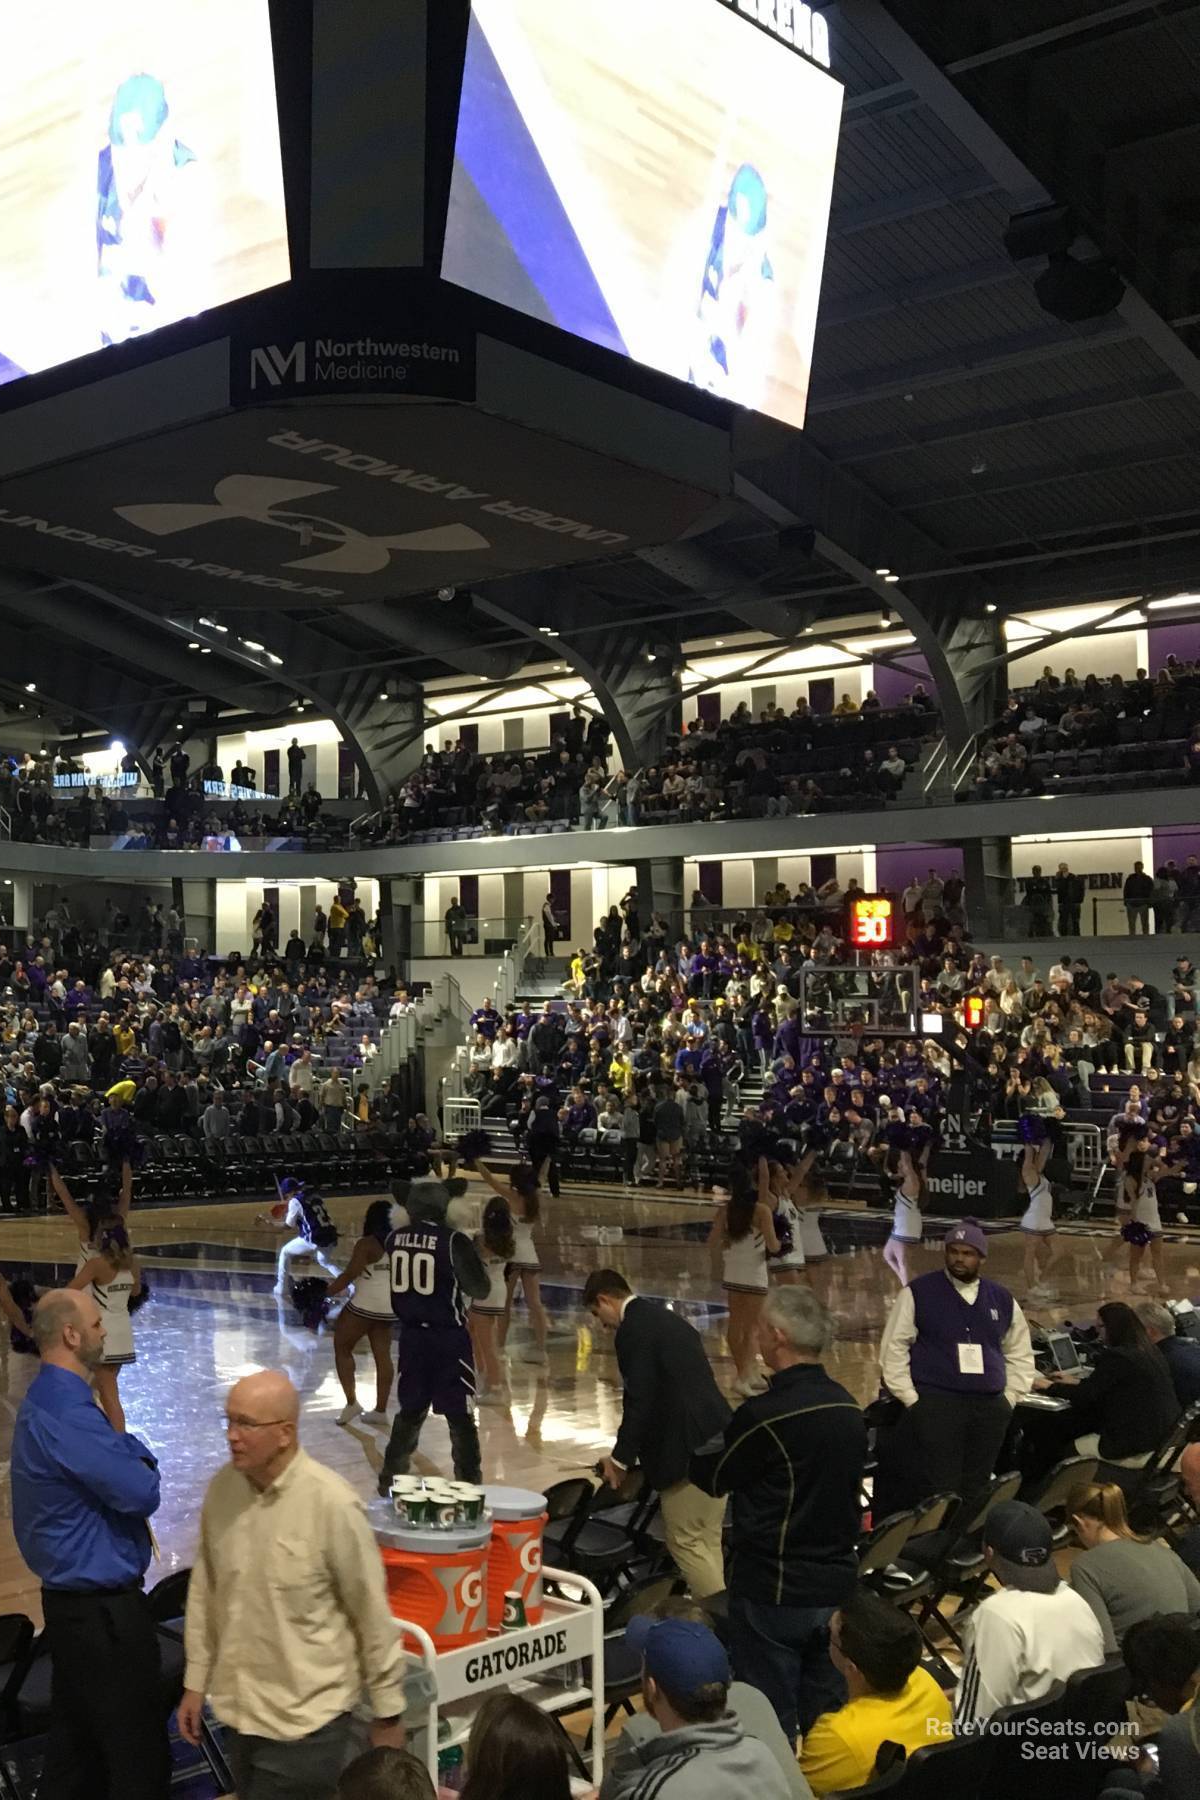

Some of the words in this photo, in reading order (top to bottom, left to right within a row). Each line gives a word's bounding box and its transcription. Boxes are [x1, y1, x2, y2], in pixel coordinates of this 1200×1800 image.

[314, 337, 460, 363] Northwestern
[314, 361, 408, 382] Medicine
[266, 429, 491, 500] ARMOUR
[480, 499, 630, 545] UNDER
[156, 557, 345, 598] ARMOUR
[857, 916, 888, 943] 30
[393, 1231, 438, 1250] WILLIE
[391, 1249, 436, 1296] 00
[520, 1539, 542, 1574] G
[461, 1570, 483, 1609] G
[465, 1629, 568, 1684] GATORADE
